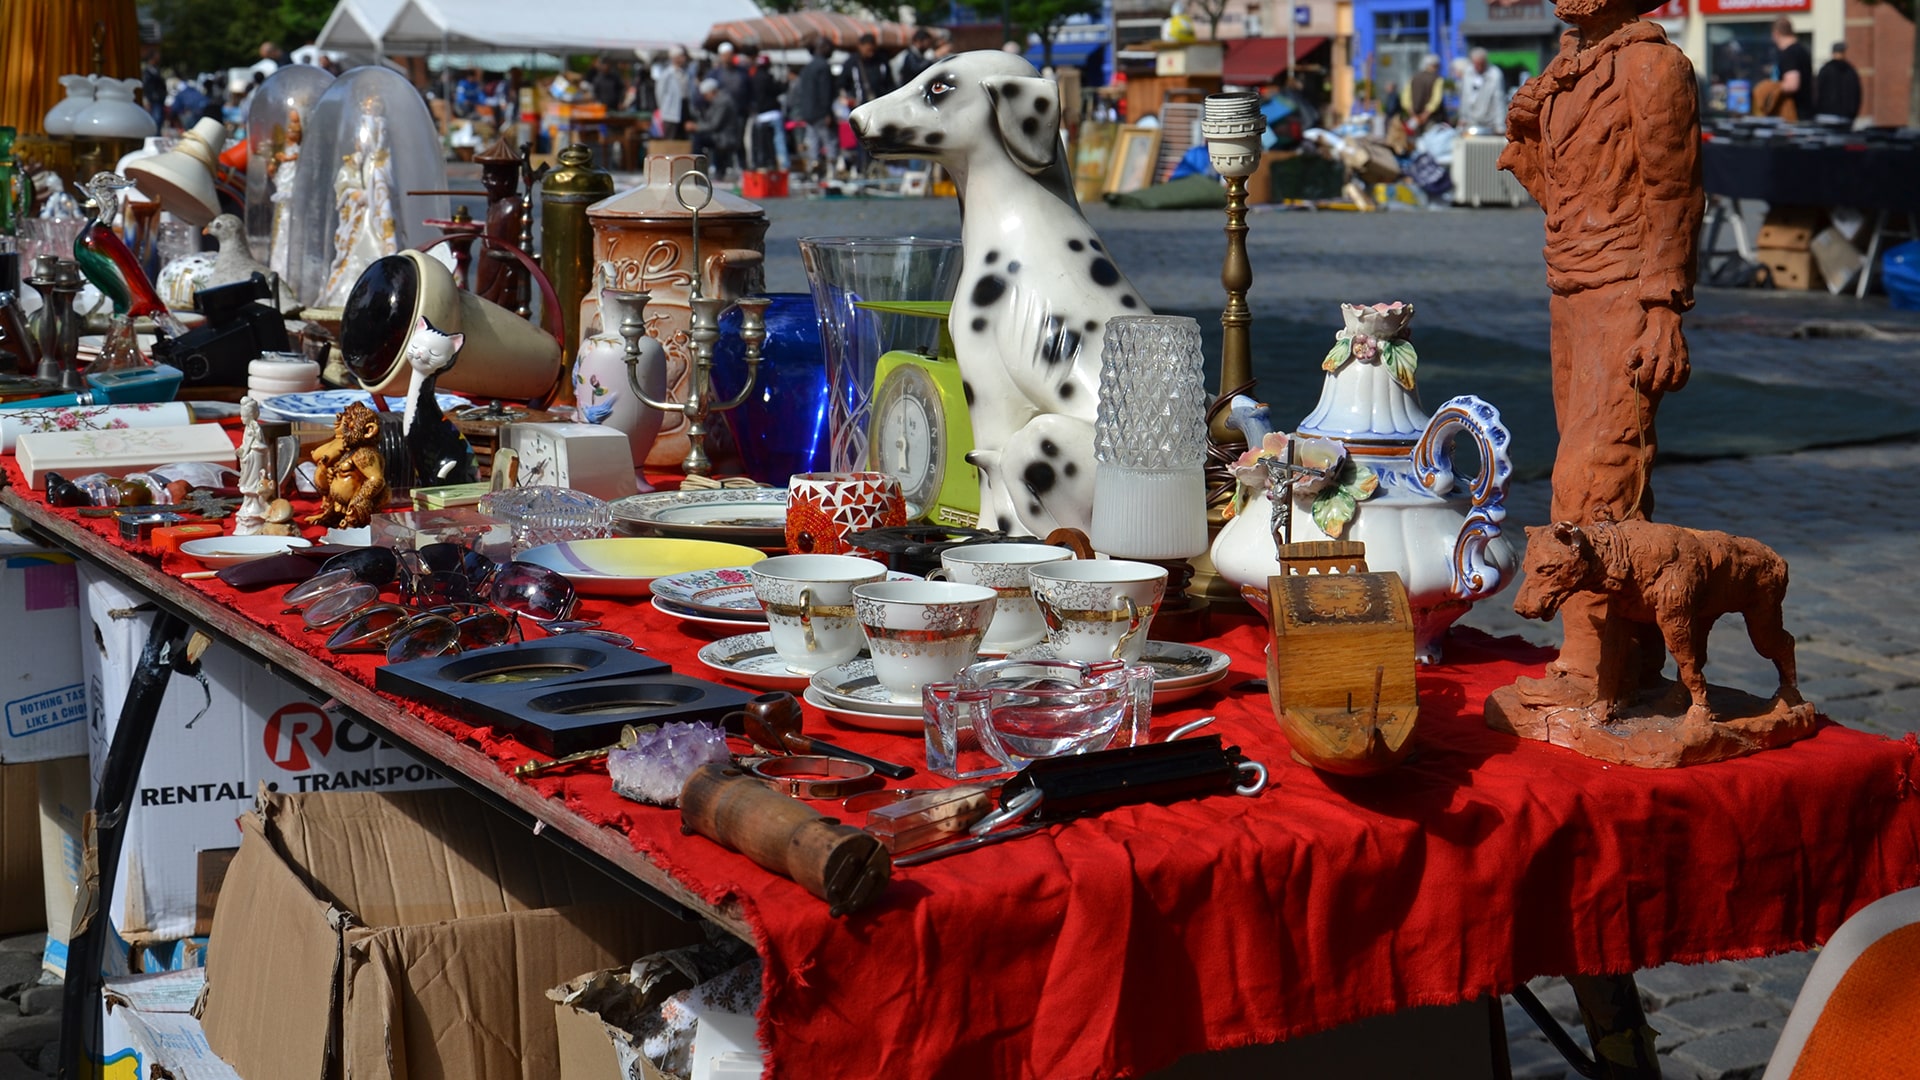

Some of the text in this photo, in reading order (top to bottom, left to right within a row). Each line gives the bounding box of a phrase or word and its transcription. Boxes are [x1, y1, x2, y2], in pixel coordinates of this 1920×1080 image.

[931, 428, 938, 438] 2
[929, 463, 937, 474] 3
[20, 695, 63, 715] NOTHING
[26, 714, 48, 729] LIKE
[52, 711, 59, 722] A
[264, 702, 395, 771] RO
[141, 781, 252, 806] RENTAL
